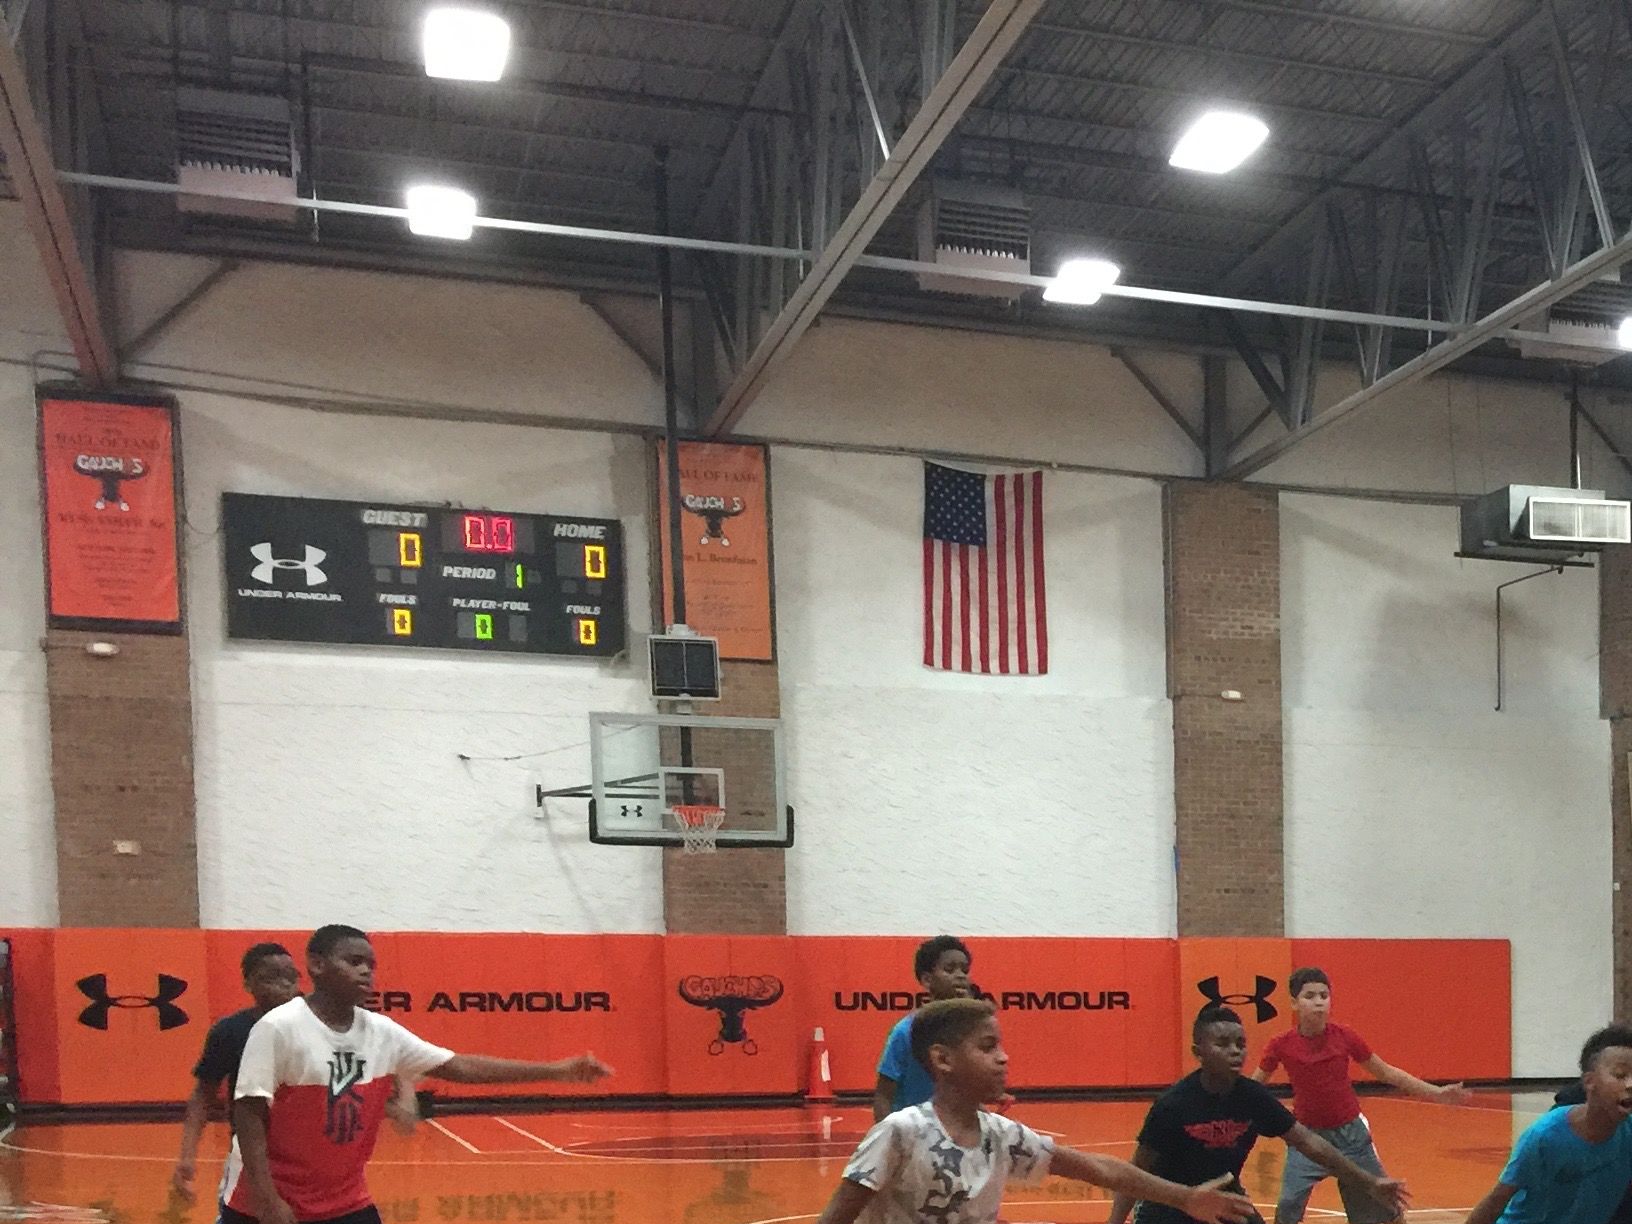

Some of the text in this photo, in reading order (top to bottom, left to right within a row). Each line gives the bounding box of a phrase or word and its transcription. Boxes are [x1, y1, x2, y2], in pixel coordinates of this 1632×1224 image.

[362, 509, 427, 527] GUEST
[554, 523, 607, 539] HOME
[442, 565, 497, 580] PERIOD
[238, 588, 342, 602] UNDER ARMOUR
[566, 604, 601, 616] FOULS
[427, 991, 611, 1013] ARMOUR
